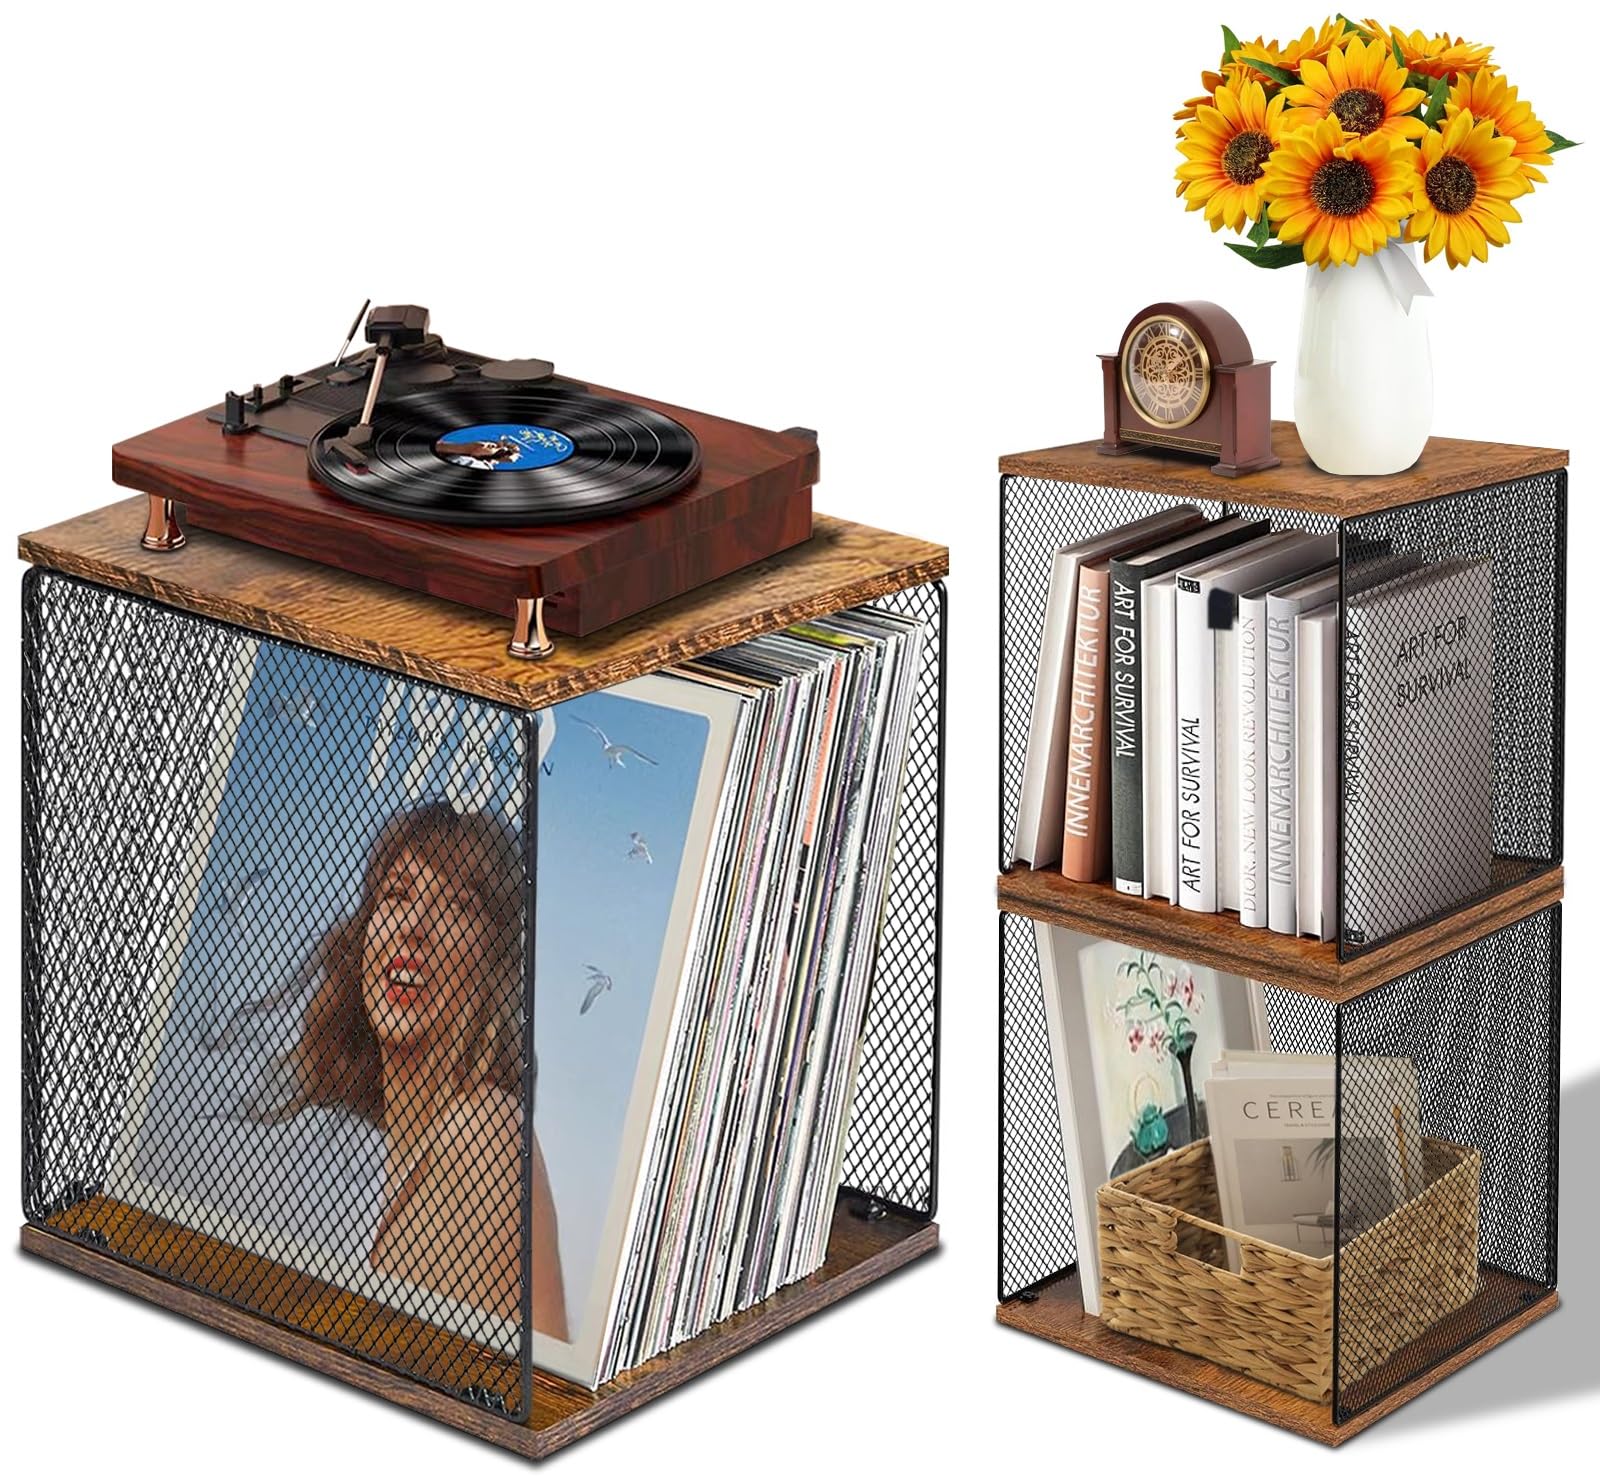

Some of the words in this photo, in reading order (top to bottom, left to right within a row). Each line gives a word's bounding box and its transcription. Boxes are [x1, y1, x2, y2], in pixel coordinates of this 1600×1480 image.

[1113, 580, 1136, 621] ART
[1114, 624, 1136, 665] FOR
[1396, 631, 1428, 668] ART
[1432, 615, 1468, 649] FOR
[1241, 616, 1257, 744] REVOLUTION
[1396, 656, 1471, 708] SURVIVAL
[1066, 585, 1102, 838] INNENARCHITEKTUR
[1114, 670, 1136, 757] SURVIVAL
[1181, 717, 1201, 804] SURVIVAL
[1267, 616, 1292, 886] INNENARCHITEKTUR
[1242, 751, 1257, 805] LOOK
[1181, 809, 1201, 850] FOR
[1242, 812, 1257, 855] NEW
[1181, 853, 1201, 893] ART
